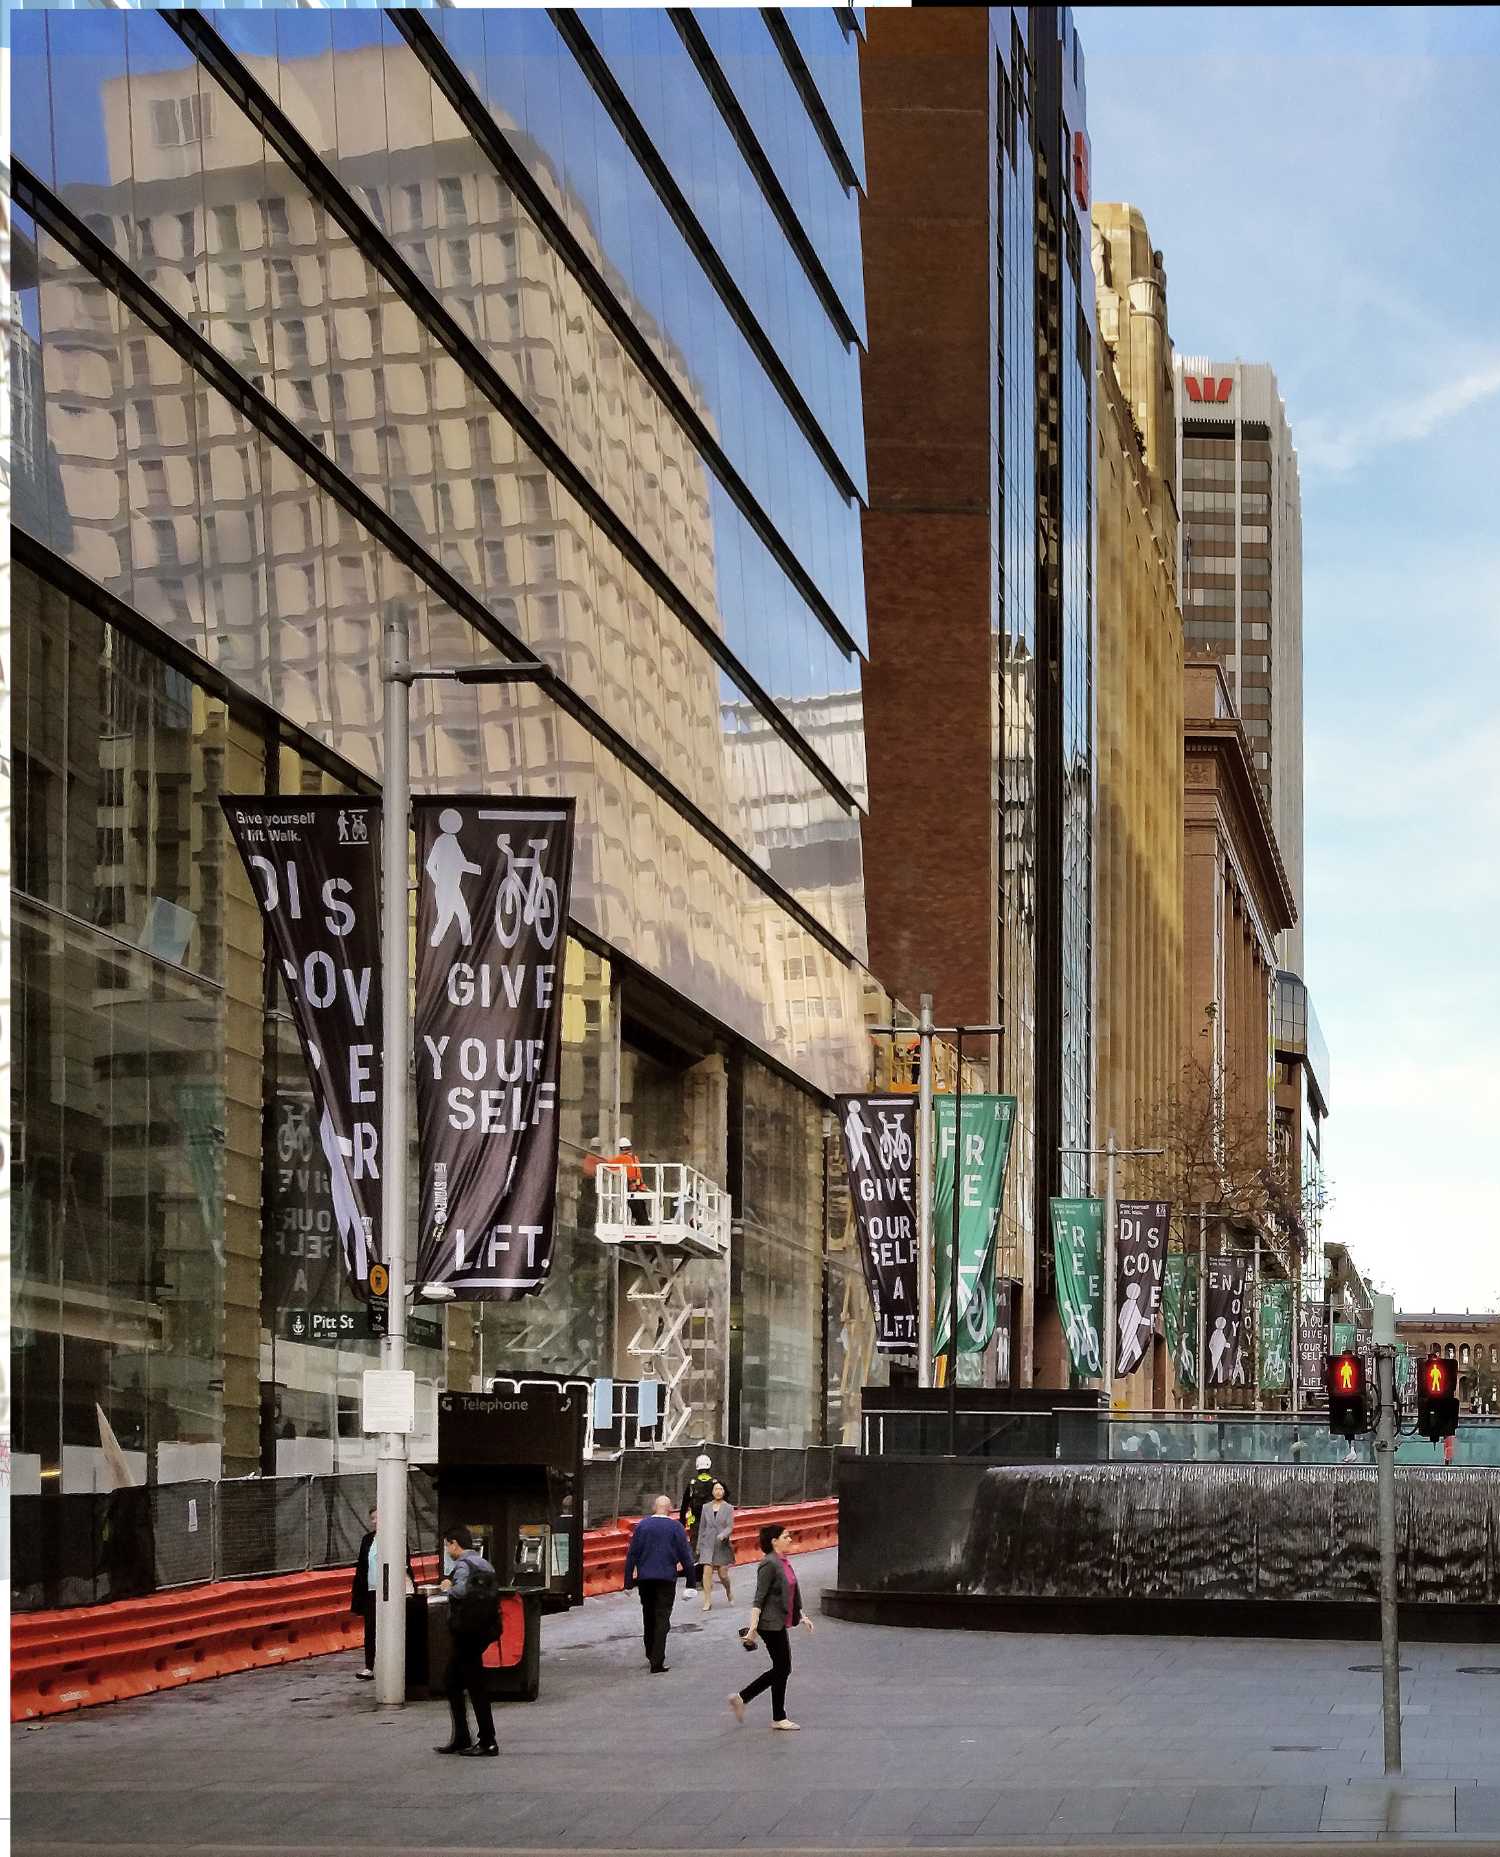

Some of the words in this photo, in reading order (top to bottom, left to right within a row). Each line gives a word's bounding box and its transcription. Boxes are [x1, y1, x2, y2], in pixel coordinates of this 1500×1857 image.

[235, 810, 262, 825] Give
[266, 811, 316, 827] yourself
[448, 963, 557, 1009] GIVE
[448, 1082, 557, 1134] SELF
[860, 1178, 911, 1202] GIVE
[860, 1215, 912, 1241] OUR
[1120, 1218, 1160, 1249] DIS
[1123, 1252, 1163, 1281] COV
[893, 1276, 904, 1300] A
[312, 1314, 338, 1329] Pitt
[339, 1314, 355, 1330] St
[1302, 1329, 1323, 1339] GIVE
[1299, 1342, 1321, 1352] YOUR
[1301, 1351, 1323, 1361] SELF
[461, 1397, 530, 1414] Telephone
